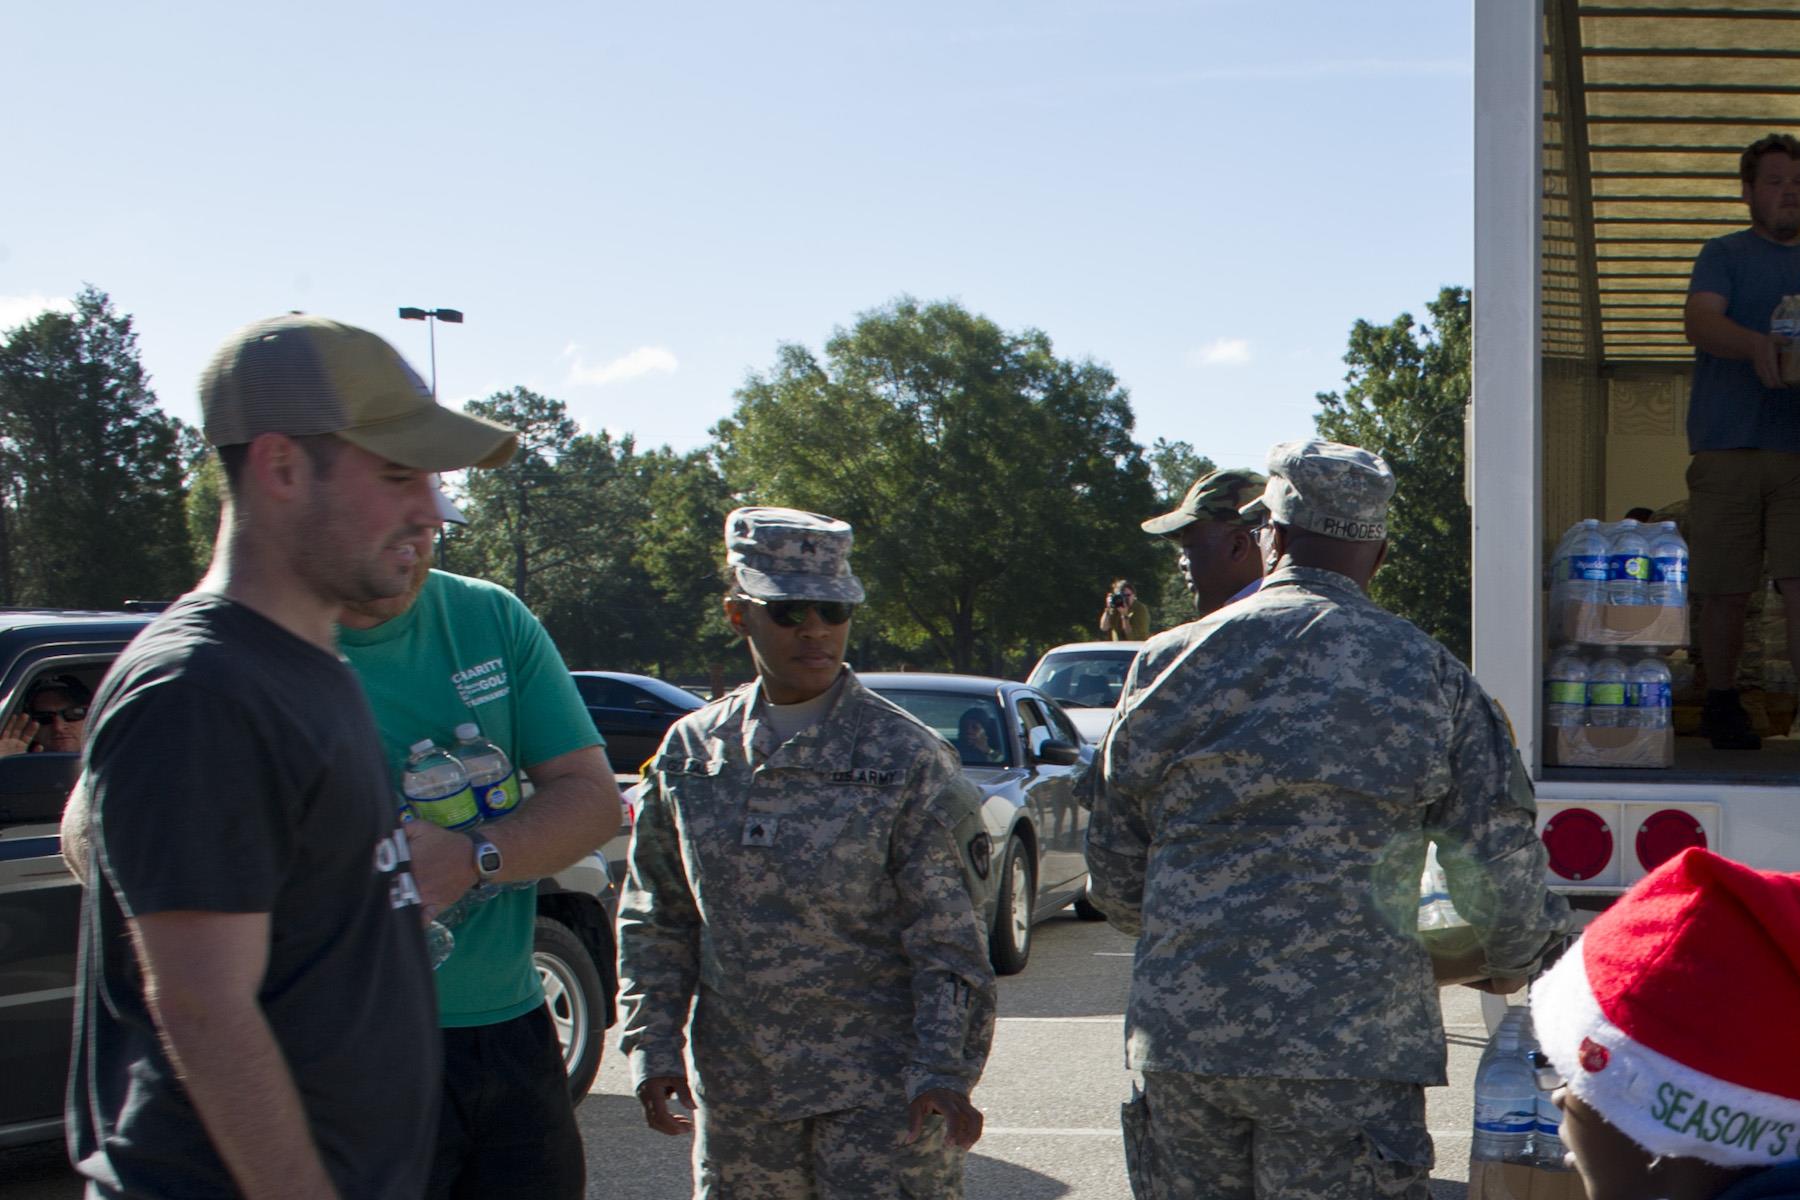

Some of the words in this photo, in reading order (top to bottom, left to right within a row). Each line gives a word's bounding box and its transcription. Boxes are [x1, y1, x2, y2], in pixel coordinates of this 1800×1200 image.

[1323, 517, 1384, 539] RHODES
[479, 672, 508, 691] GOLF
[856, 769, 897, 785] ARMY
[1651, 1082, 1796, 1157] SEASON'S
